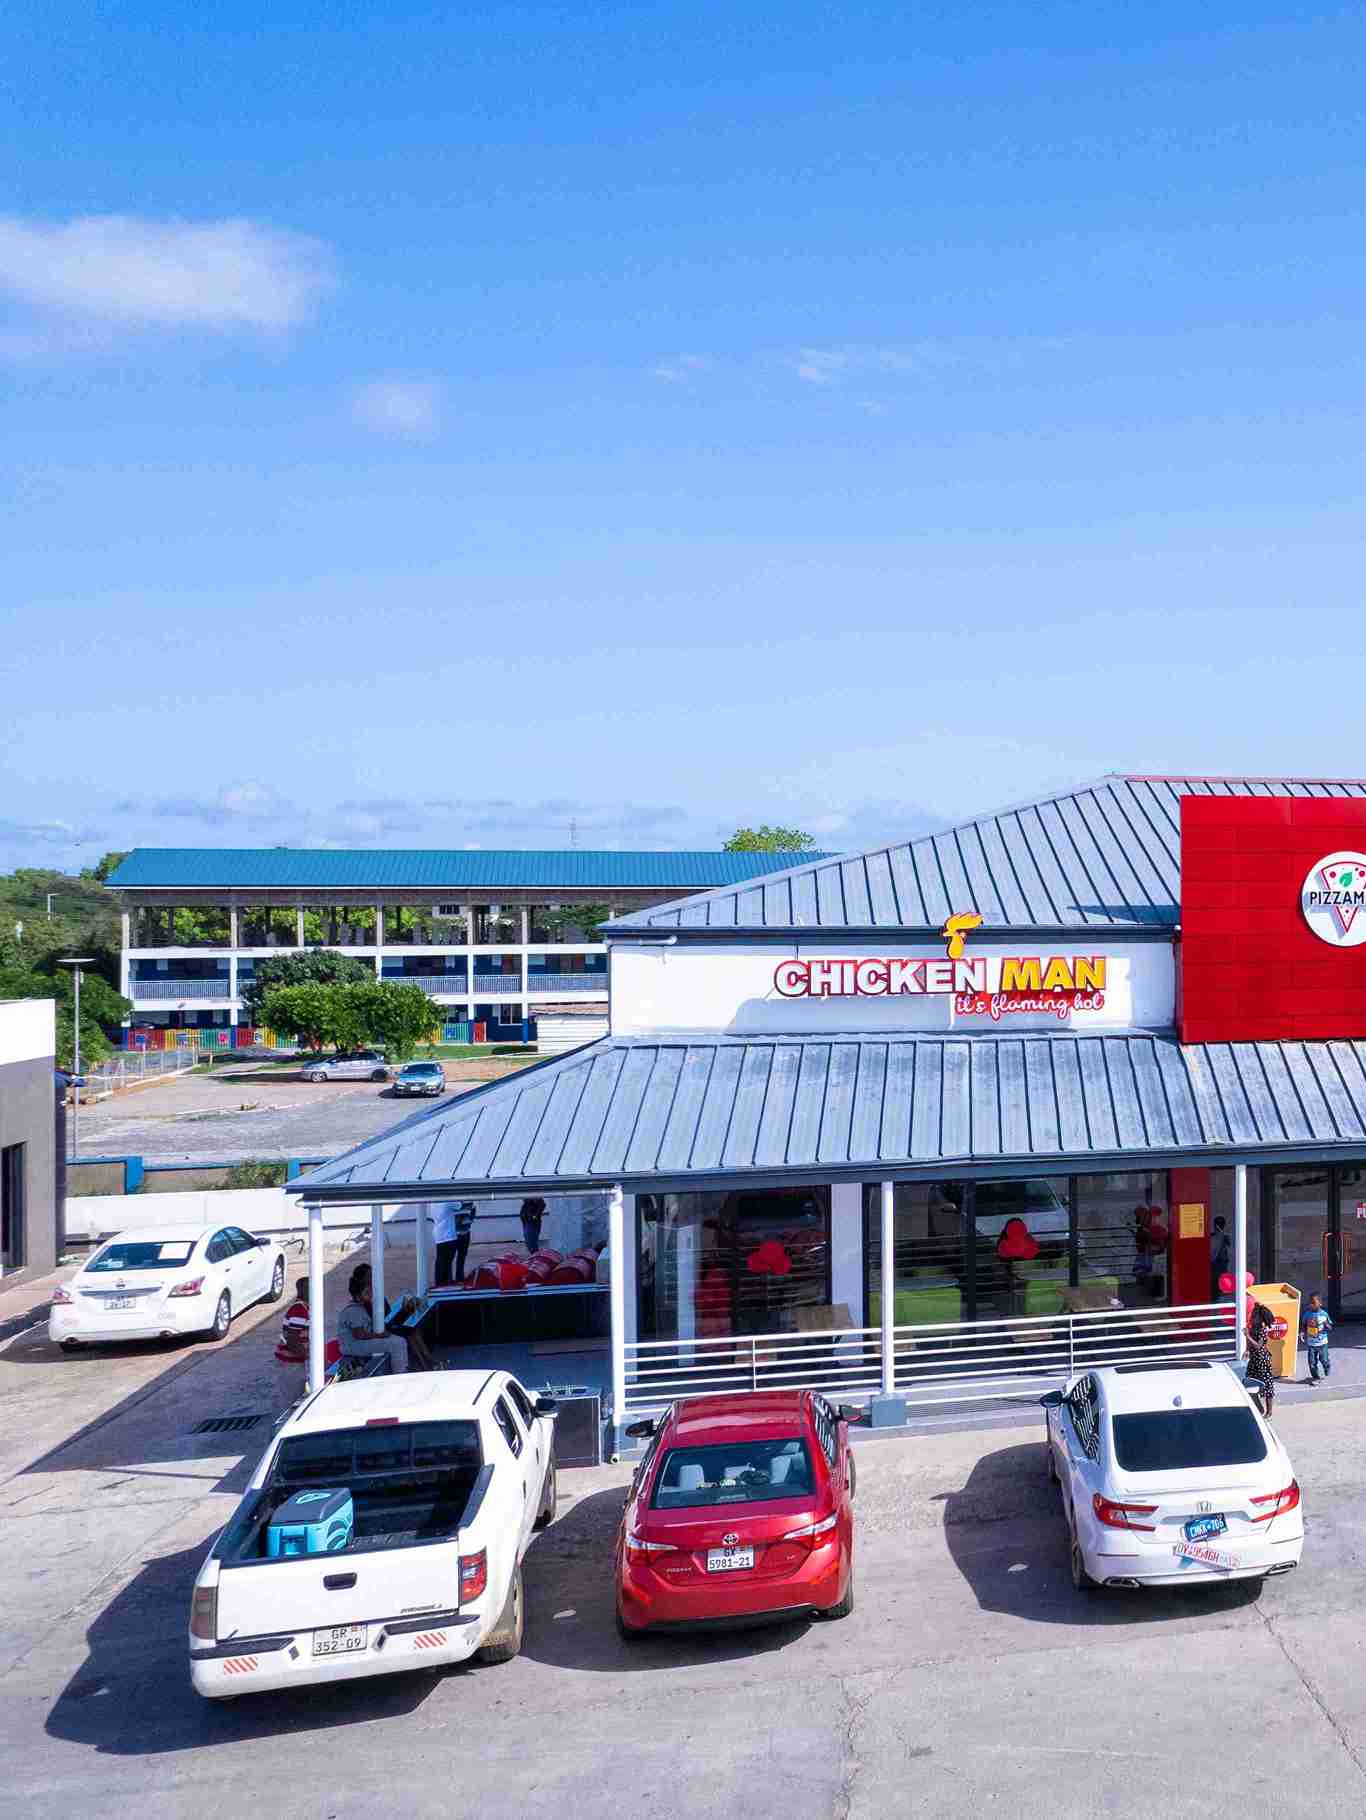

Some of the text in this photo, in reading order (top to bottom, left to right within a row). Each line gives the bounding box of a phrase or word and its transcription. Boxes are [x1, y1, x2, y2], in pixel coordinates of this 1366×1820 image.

[775, 957, 1106, 996] CHICKEN MAN
[990, 993, 1068, 1019] flaming
[709, 1557, 750, 1569] 5981-21
[331, 1628, 348, 1640] GR
[315, 1638, 361, 1652] 352-09
